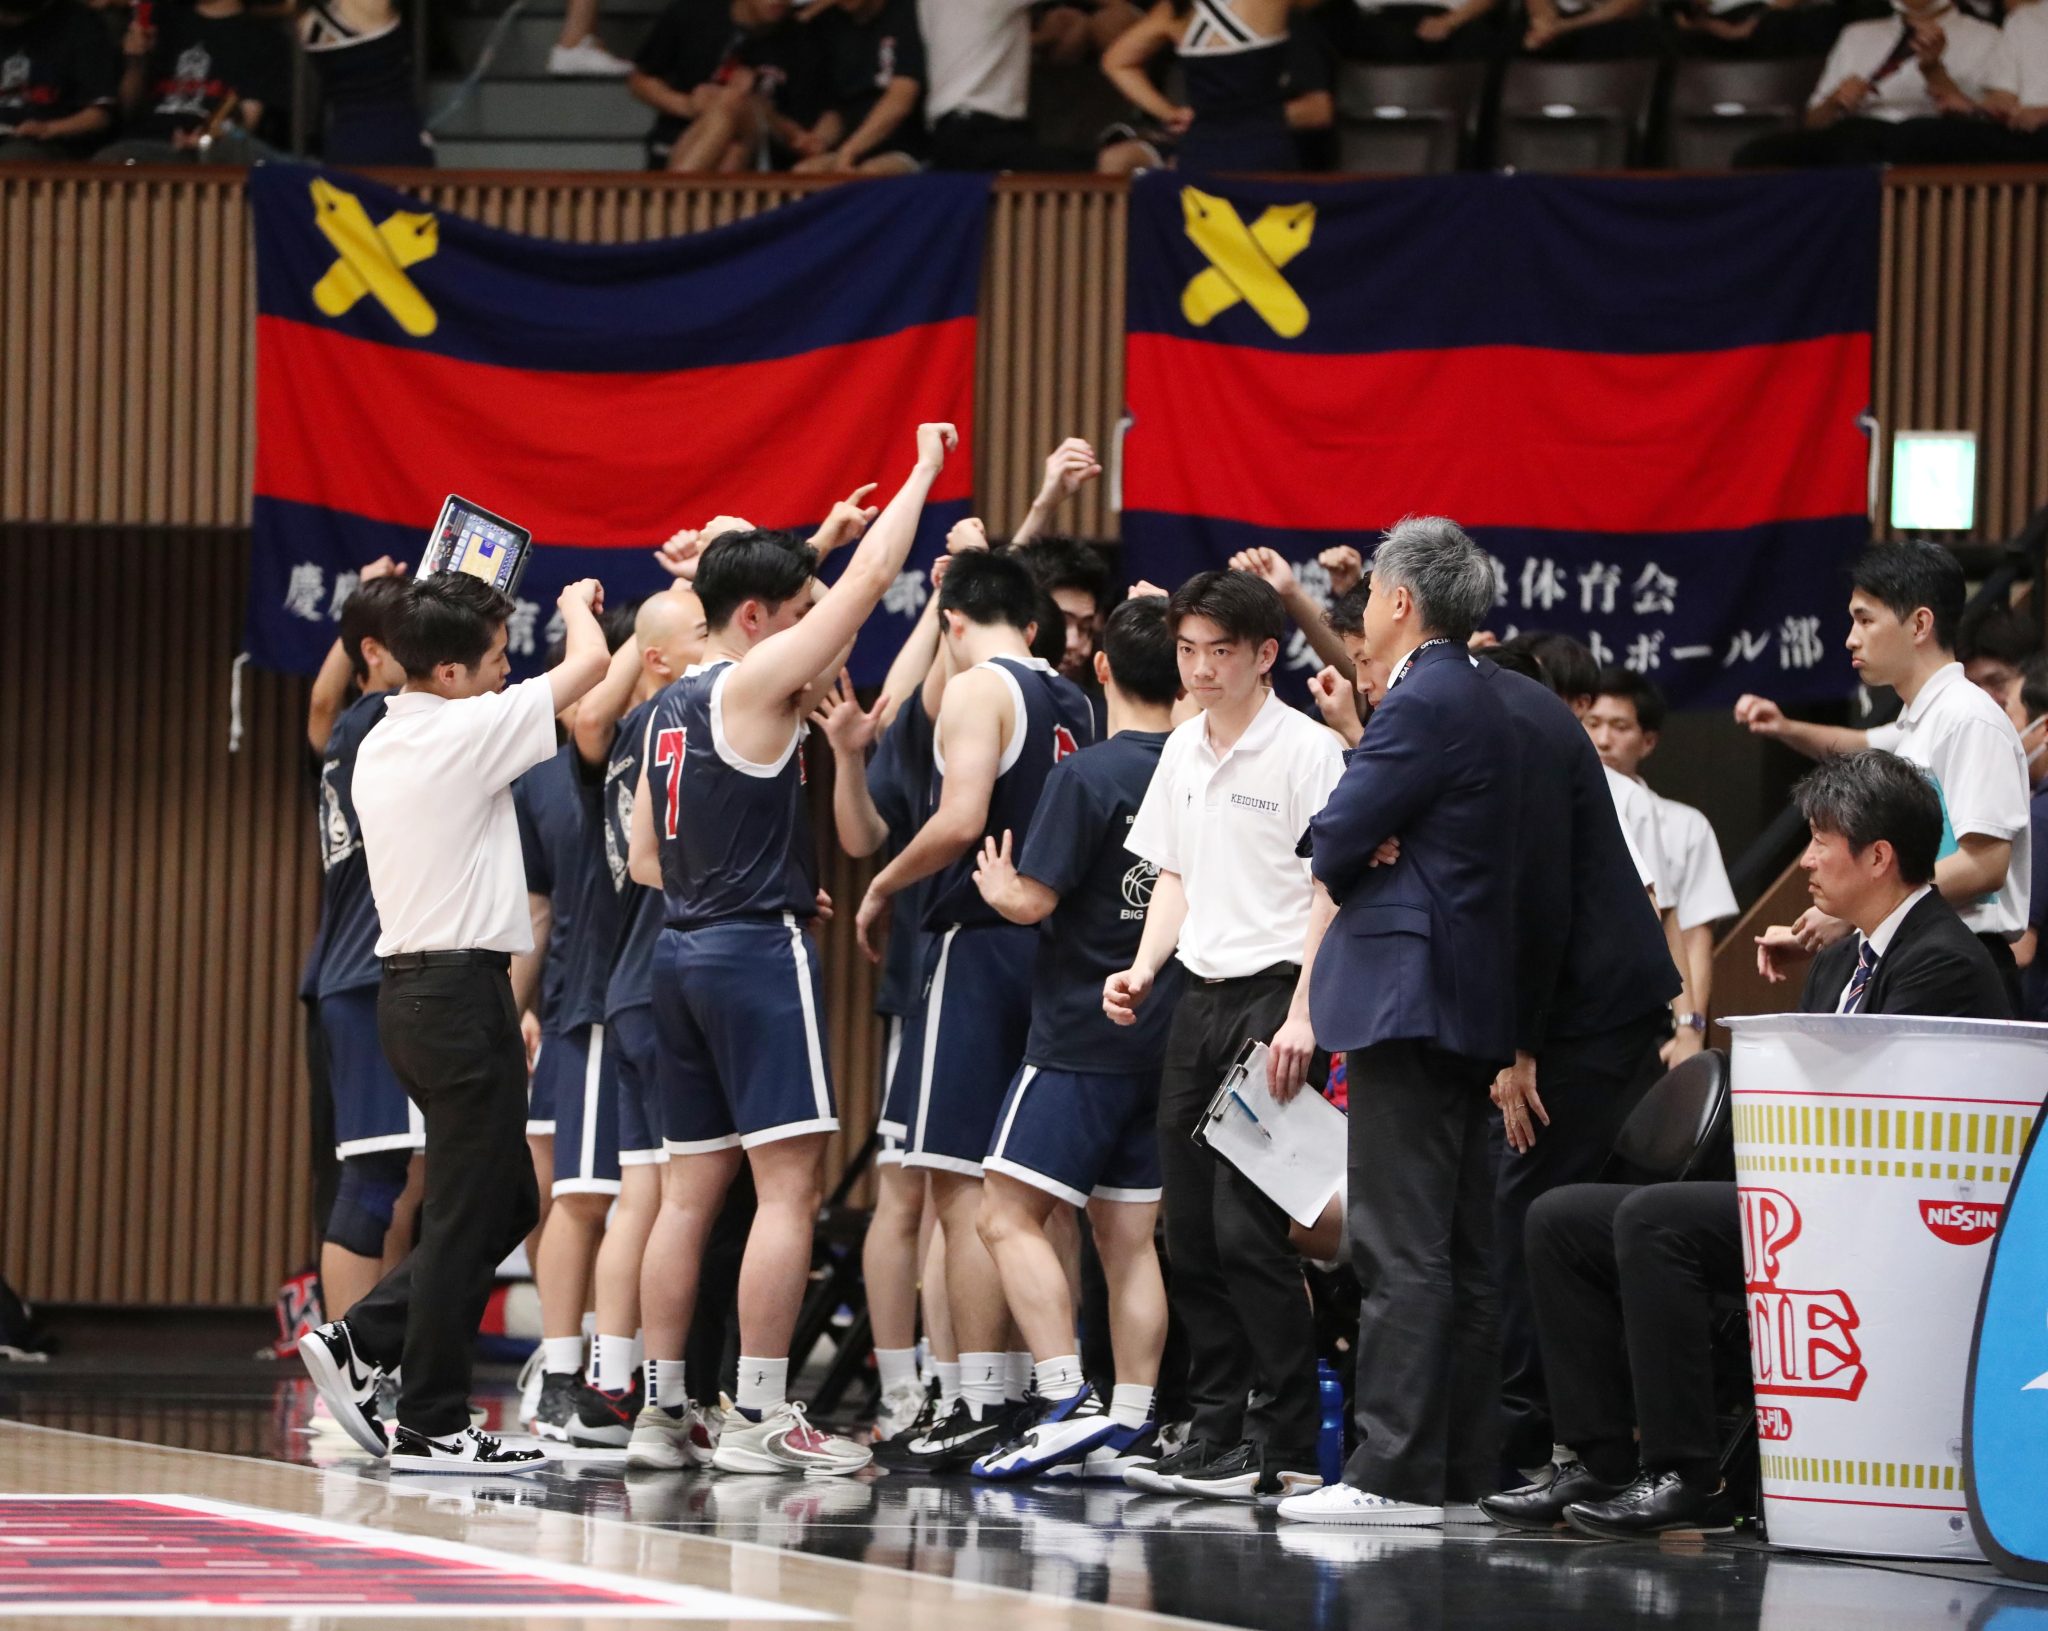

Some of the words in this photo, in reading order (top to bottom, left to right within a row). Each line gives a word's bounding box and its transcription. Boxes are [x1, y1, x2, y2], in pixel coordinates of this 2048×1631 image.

[655, 727, 687, 840] 7
[1120, 910, 1144, 920] BIG
[1927, 1204, 1998, 1232] NISSIN
